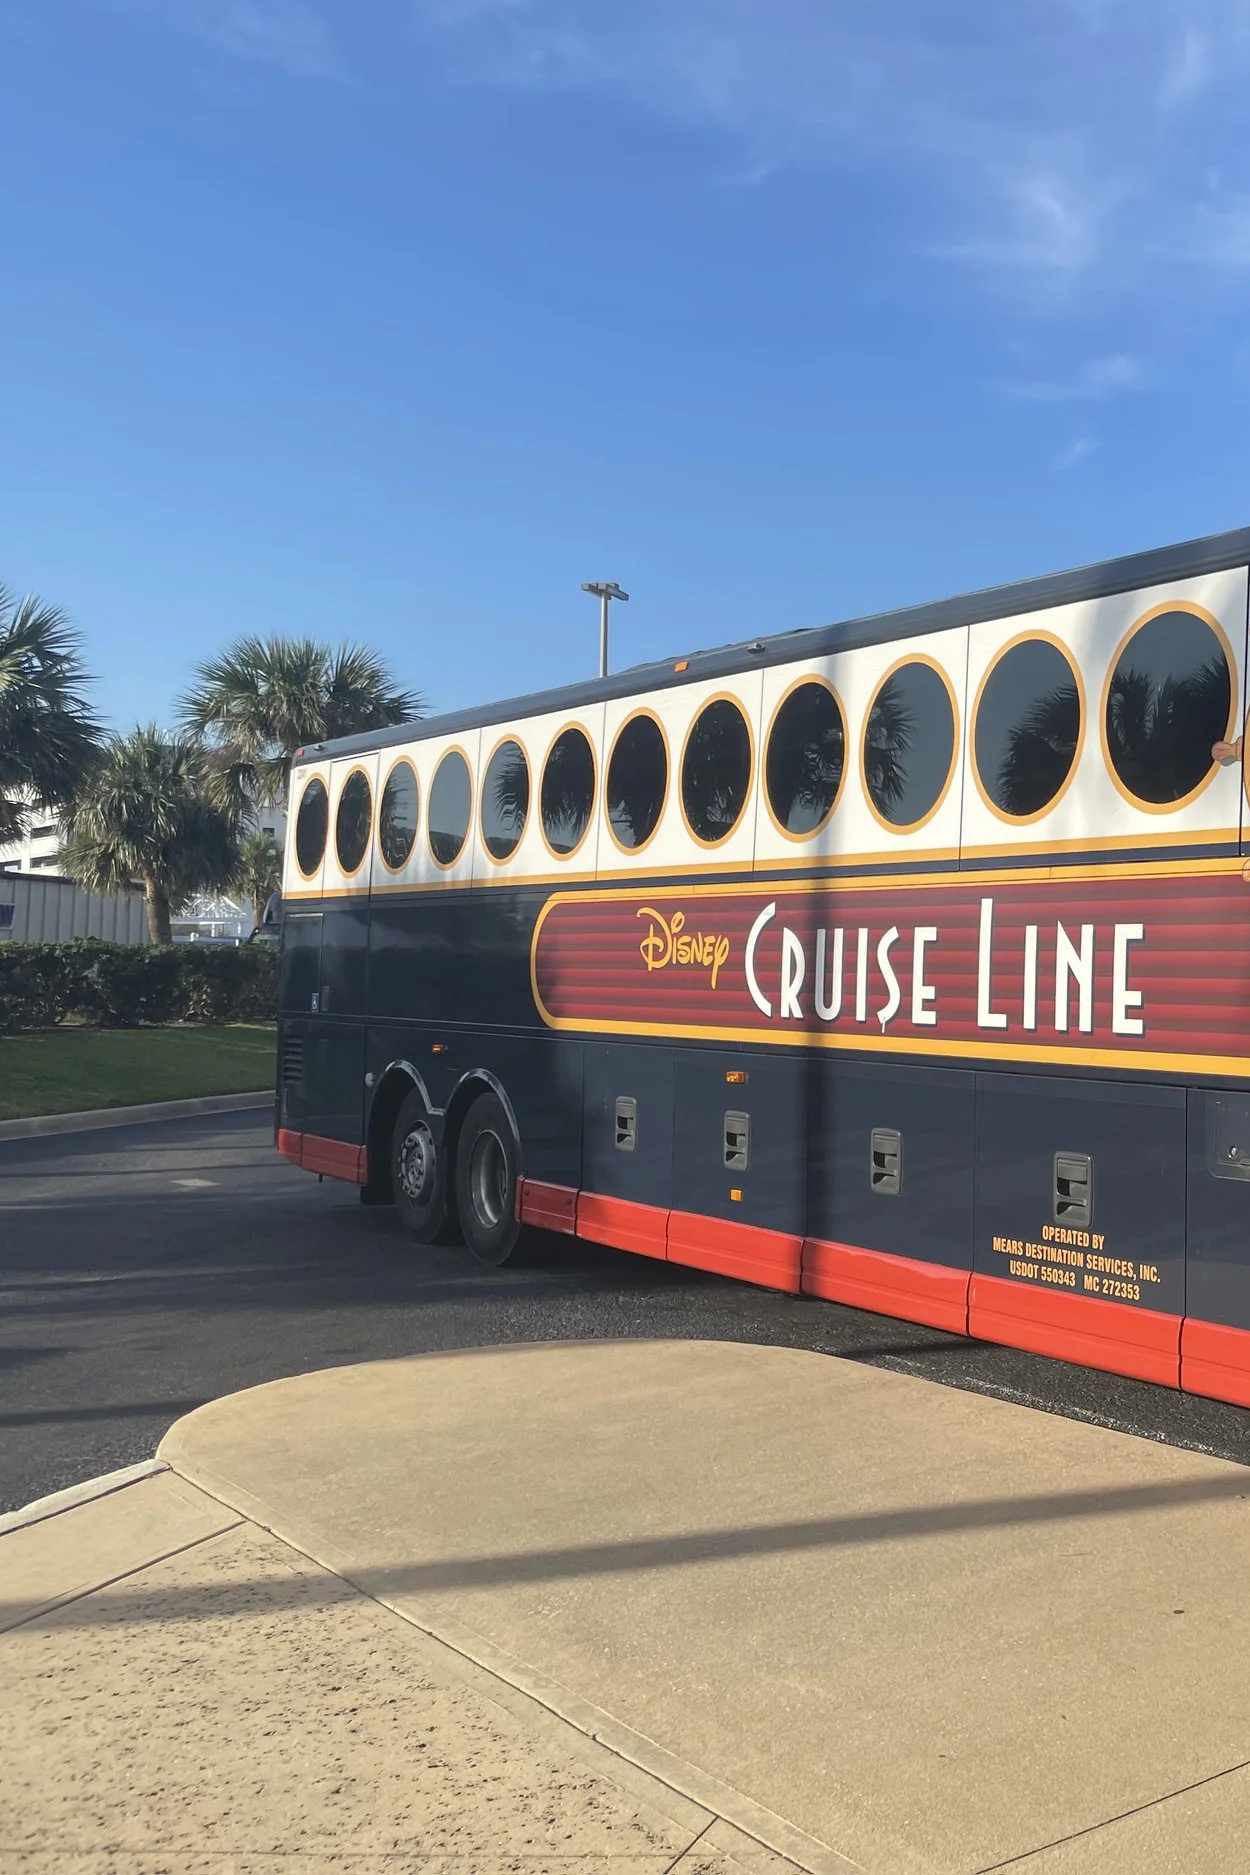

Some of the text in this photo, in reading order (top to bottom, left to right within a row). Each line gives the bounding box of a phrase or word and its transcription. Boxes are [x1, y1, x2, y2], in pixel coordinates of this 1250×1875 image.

[744, 901, 938, 1033] CRUISE
[977, 897, 1145, 1035] LINE
[993, 1236, 1161, 1283] MEARS DESTINATION SERVICES, INC.
[1042, 1225, 1105, 1250] OPERATED BY
[1009, 1259, 1140, 1301] USDOT 550343 MC 272353
